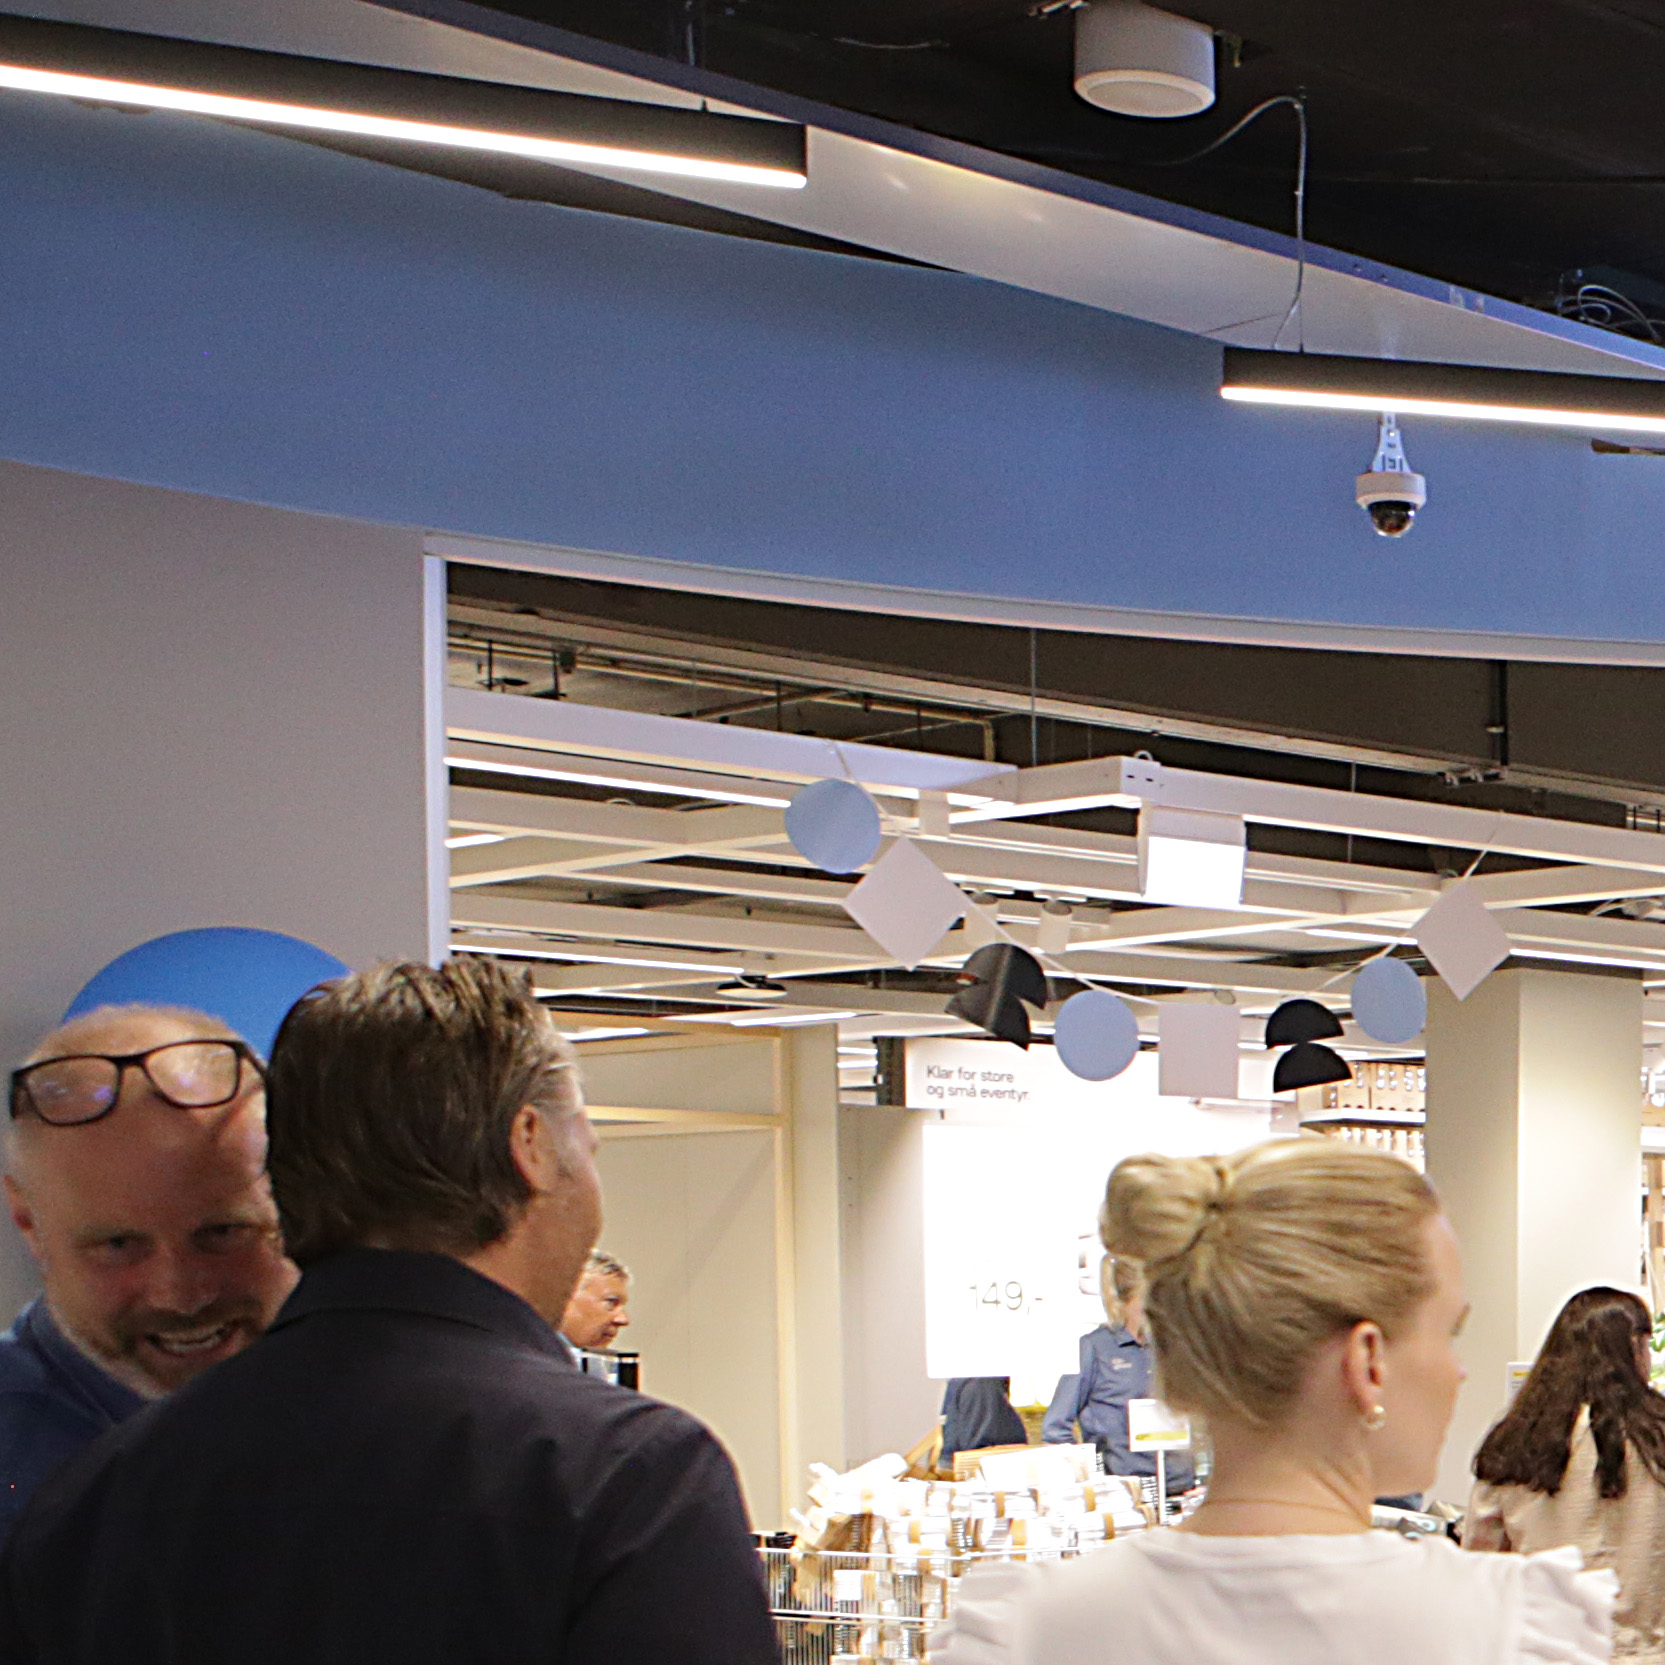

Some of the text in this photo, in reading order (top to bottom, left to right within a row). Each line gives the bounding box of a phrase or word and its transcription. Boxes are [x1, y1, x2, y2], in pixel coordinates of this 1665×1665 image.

[926, 1064, 1014, 1083] Klar for store
[926, 1085, 944, 1099] og
